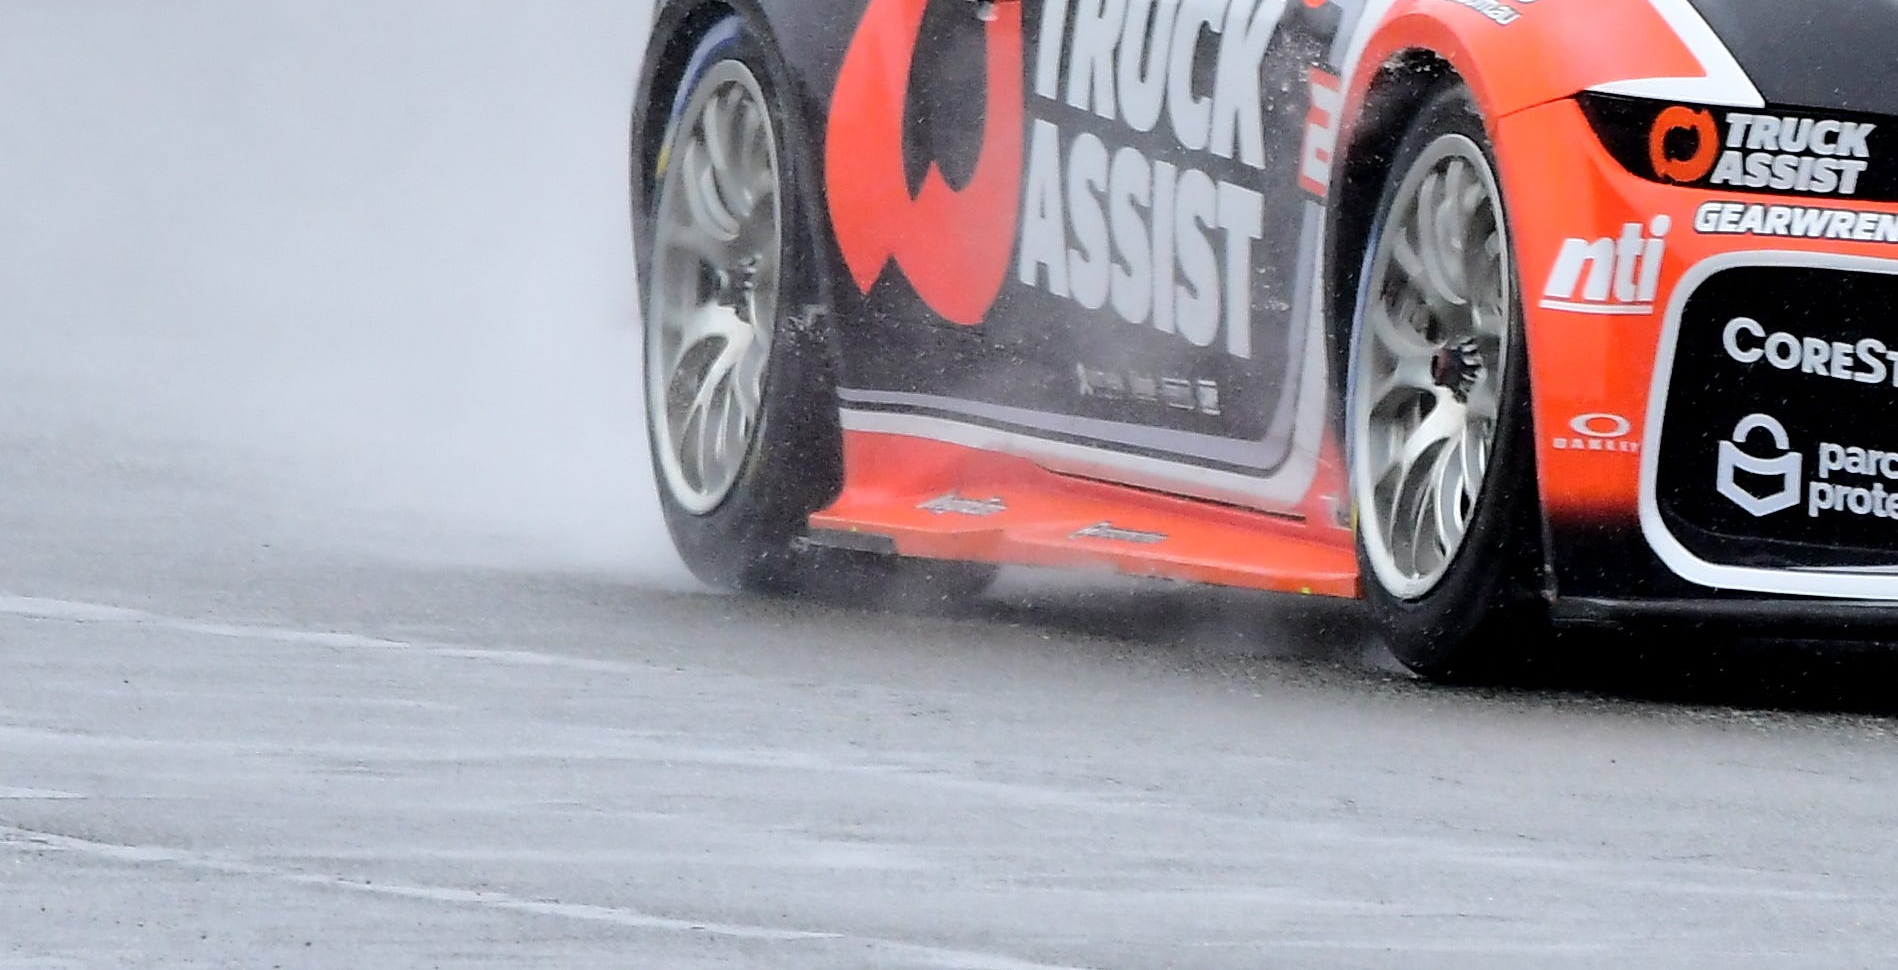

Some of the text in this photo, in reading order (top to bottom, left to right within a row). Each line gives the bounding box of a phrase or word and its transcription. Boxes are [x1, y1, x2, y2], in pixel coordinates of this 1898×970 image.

[1724, 111, 1877, 159] TRUCK
[1710, 151, 1867, 195] ASSIST
[1018, 119, 1264, 359] ASSIST
[1545, 215, 1672, 302] nti
